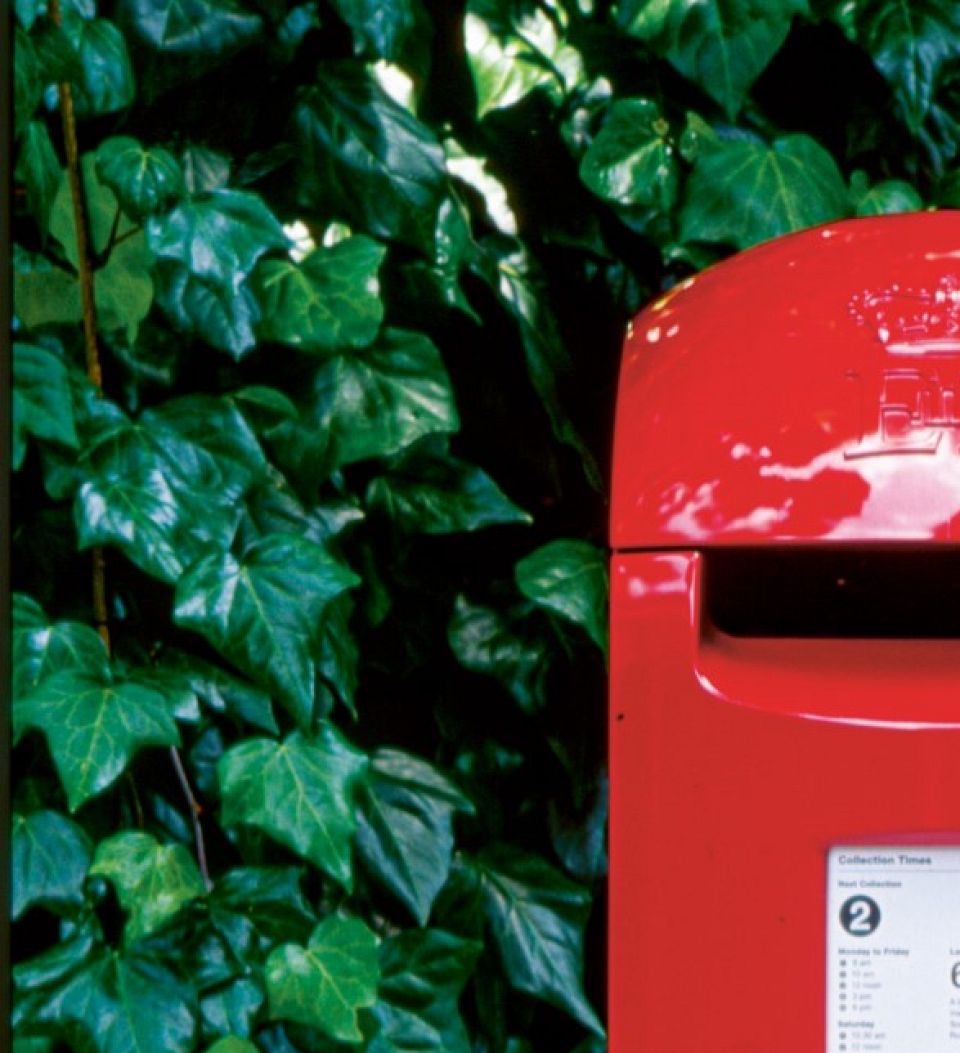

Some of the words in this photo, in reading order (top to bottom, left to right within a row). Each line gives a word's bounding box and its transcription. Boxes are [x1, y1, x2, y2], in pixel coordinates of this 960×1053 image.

[838, 855, 895, 865] Collection
[898, 855, 932, 865] Times
[838, 880, 858, 888] Next
[860, 880, 902, 888] Collection
[838, 948, 870, 957] Monday
[872, 948, 882, 956] to
[884, 948, 910, 957] Friday
[837, 1019, 876, 1029] Saturday
